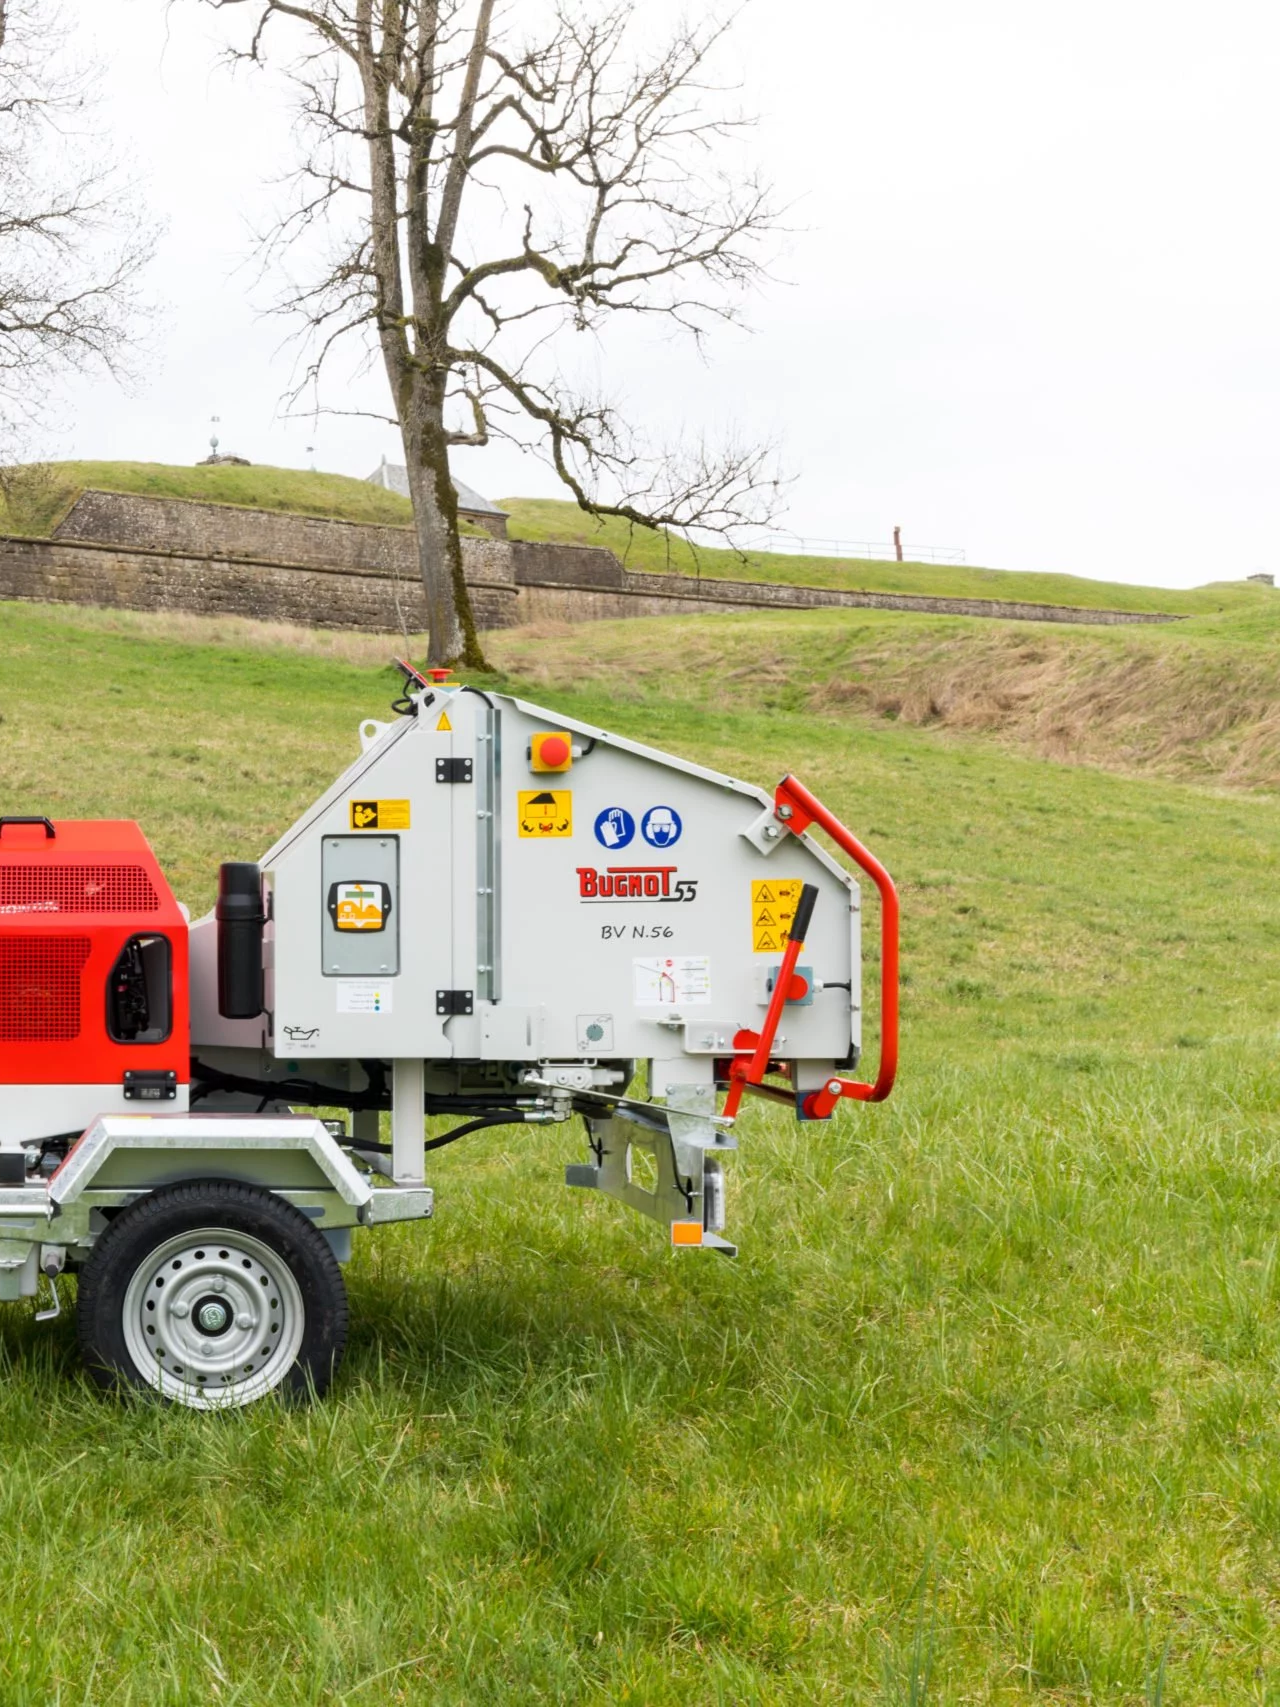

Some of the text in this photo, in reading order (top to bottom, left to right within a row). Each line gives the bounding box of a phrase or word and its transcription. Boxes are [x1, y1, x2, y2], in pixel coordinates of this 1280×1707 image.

[576, 866, 699, 902] BUGNOT 55
[601, 925, 674, 939] BV N.56
